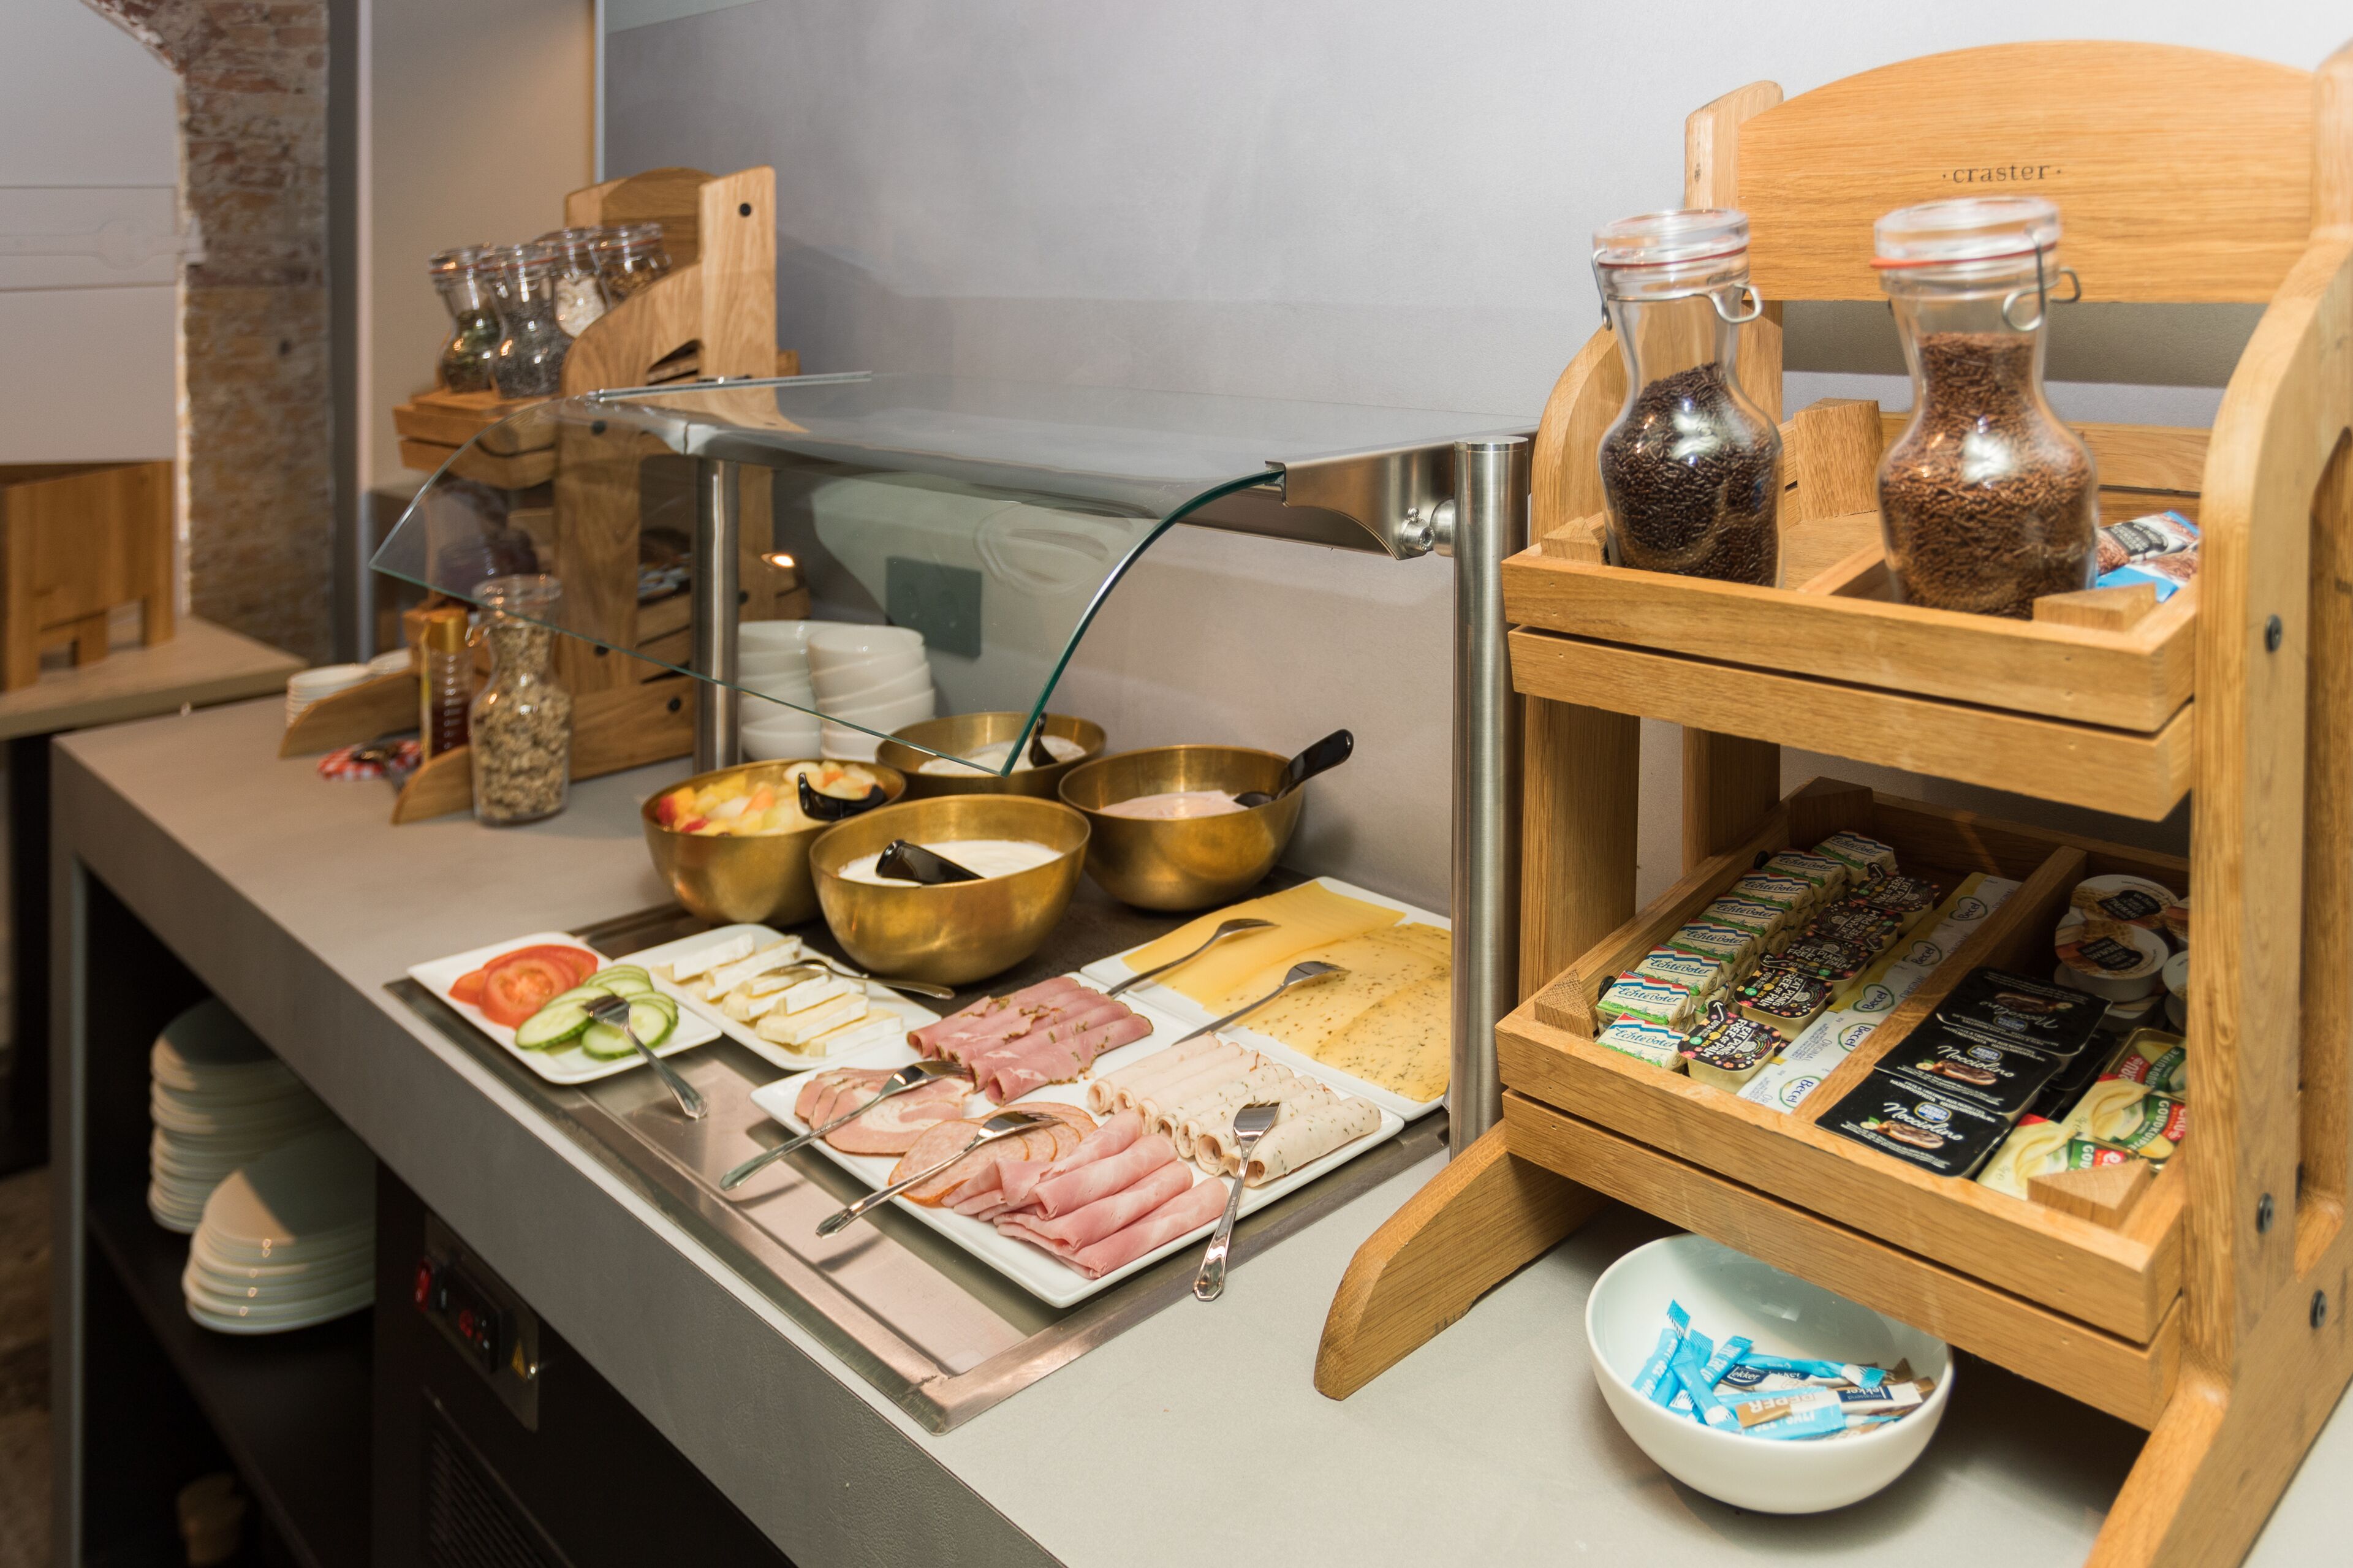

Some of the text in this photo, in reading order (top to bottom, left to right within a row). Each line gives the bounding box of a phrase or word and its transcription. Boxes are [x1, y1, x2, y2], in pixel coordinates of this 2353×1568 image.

[1744, 879, 1775, 890] Echte
[1888, 876, 1905, 890] FREE
[1716, 902, 1777, 917] Echte Boter
[1958, 902, 1980, 919] Becel
[1686, 928, 1748, 944] Echte Boter
[1787, 949, 1814, 960] FREE
[1825, 960, 1852, 969] PALM
[1800, 945, 1847, 964] EAT PLANTS
[1911, 946, 1936, 965] Becel
[1650, 958, 1712, 974] Echte Boter
[1618, 986, 1681, 1002] Echte Boter
[1757, 993, 1778, 1007] PALM
[1773, 977, 1803, 1007] EAT PLANTS
[1862, 990, 1889, 1010] Becel
[1979, 1000, 2058, 1029] Nocciolino
[1615, 1028, 1678, 1047] Echte Boter
[1725, 1019, 1748, 1038] FREE
[1845, 1026, 1871, 1047] Becel
[1700, 1042, 1724, 1058] PALM
[1716, 1026, 1752, 1056] EAT PLANTS
[1804, 1038, 1832, 1062] ORIGINAL
[1936, 1045, 2015, 1078] Nocciolino
[2146, 1048, 2180, 1087] OUDKUIPJE
[1786, 1079, 1814, 1103] Becel
[1883, 1102, 1963, 1143] Nocciolino
[2127, 1100, 2170, 1150] GOUDKUIPJE
